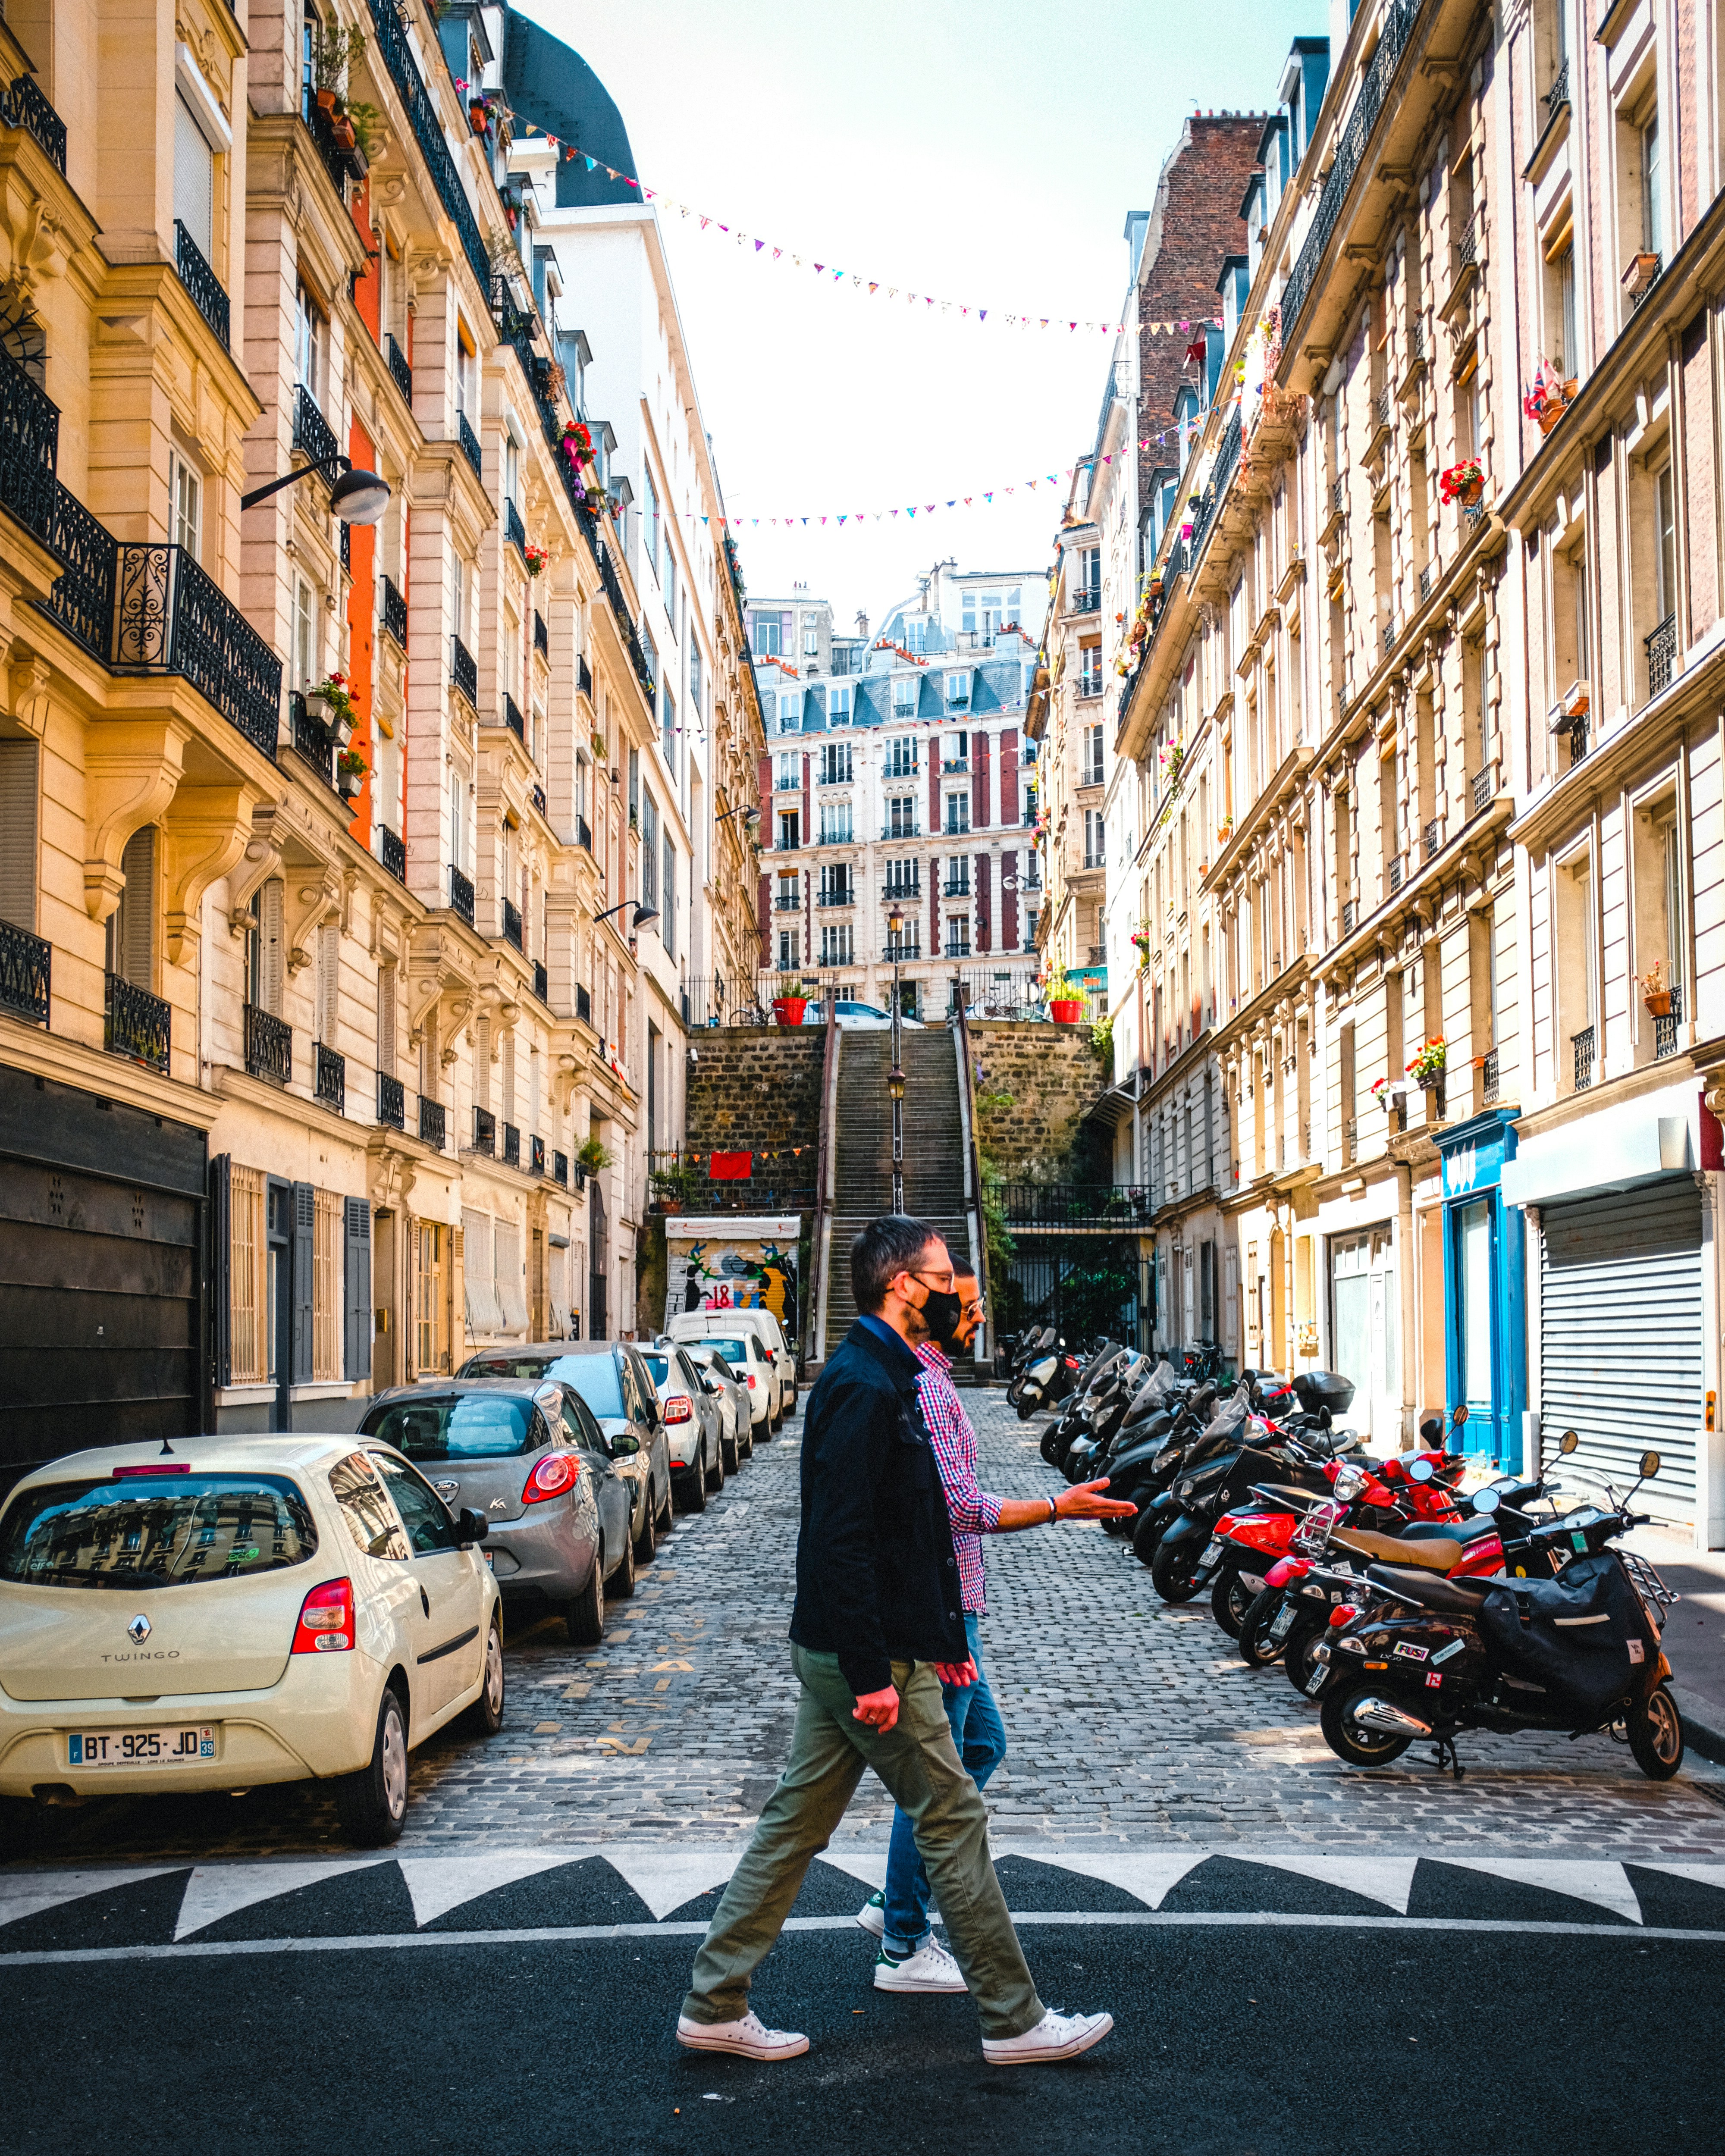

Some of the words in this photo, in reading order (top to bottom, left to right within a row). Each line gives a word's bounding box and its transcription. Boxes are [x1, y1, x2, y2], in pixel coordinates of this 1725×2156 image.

[714, 1285, 729, 1307] 18
[100, 1651, 180, 1662] TWINGO
[1398, 1644, 1426, 1659] FUSI
[85, 1731, 198, 1760] BT-925-JD
[201, 1742, 213, 1754] 39
